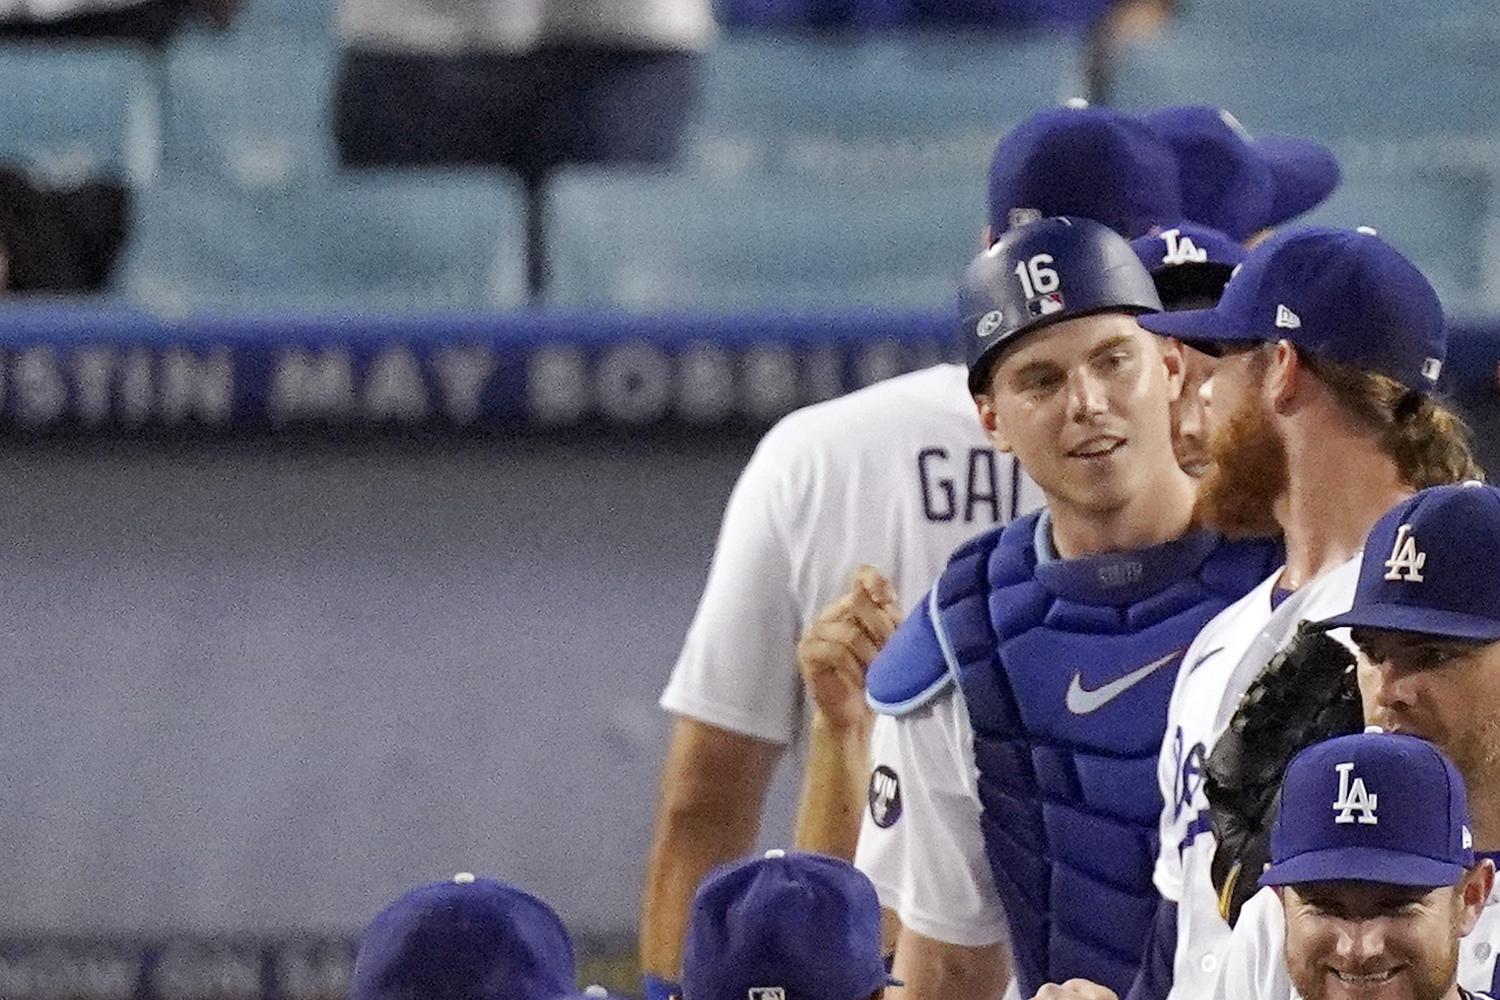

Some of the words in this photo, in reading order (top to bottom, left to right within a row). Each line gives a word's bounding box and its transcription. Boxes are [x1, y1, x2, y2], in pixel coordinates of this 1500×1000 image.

[1159, 229, 1207, 263] LA
[1013, 254, 1061, 299] 16
[0, 344, 236, 421] STIN
[272, 343, 490, 421] MAY
[1384, 523, 1427, 583] LA
[1333, 762, 1378, 825] LA
